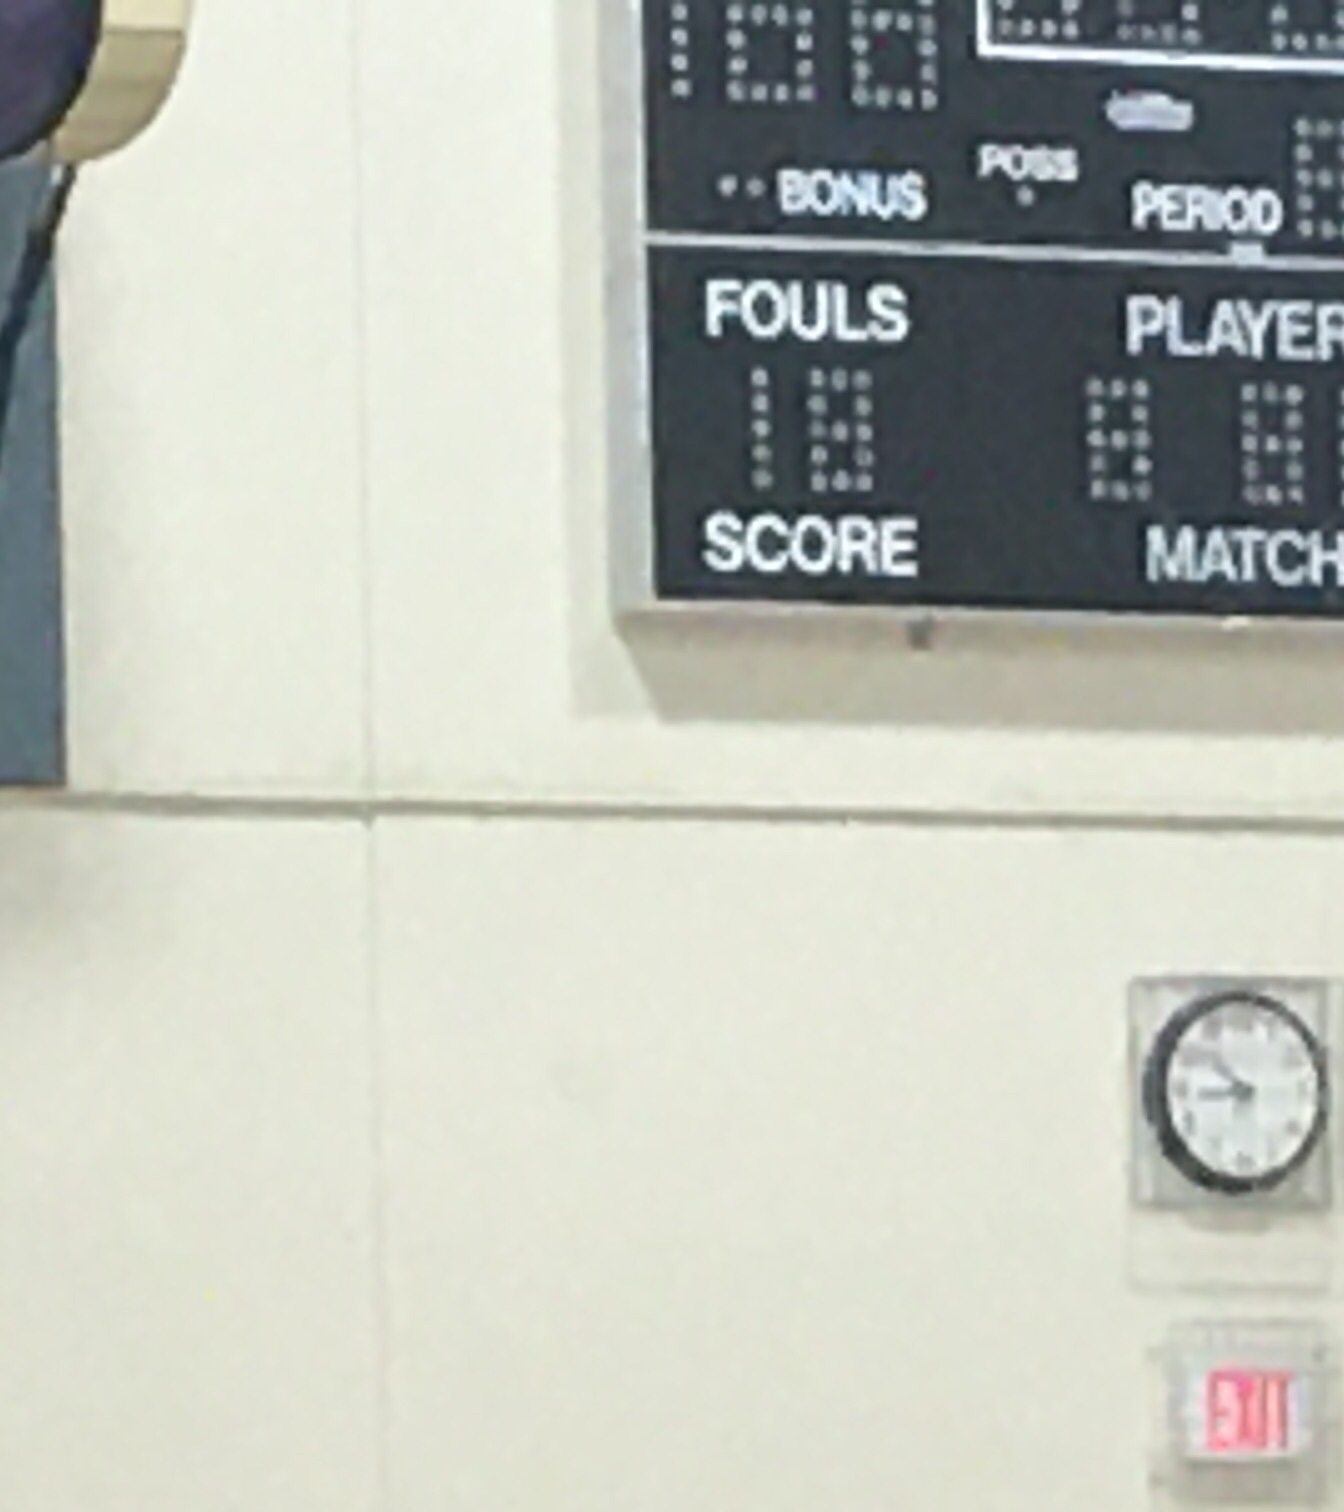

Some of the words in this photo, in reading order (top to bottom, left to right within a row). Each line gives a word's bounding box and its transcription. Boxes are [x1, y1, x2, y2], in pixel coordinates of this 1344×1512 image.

[779, 170, 927, 219] BONUS
[1132, 183, 1284, 235] PERIOD
[705, 279, 909, 343] FOULS
[704, 513, 918, 578] SCORE
[1206, 1369, 1292, 1450] EXIT
